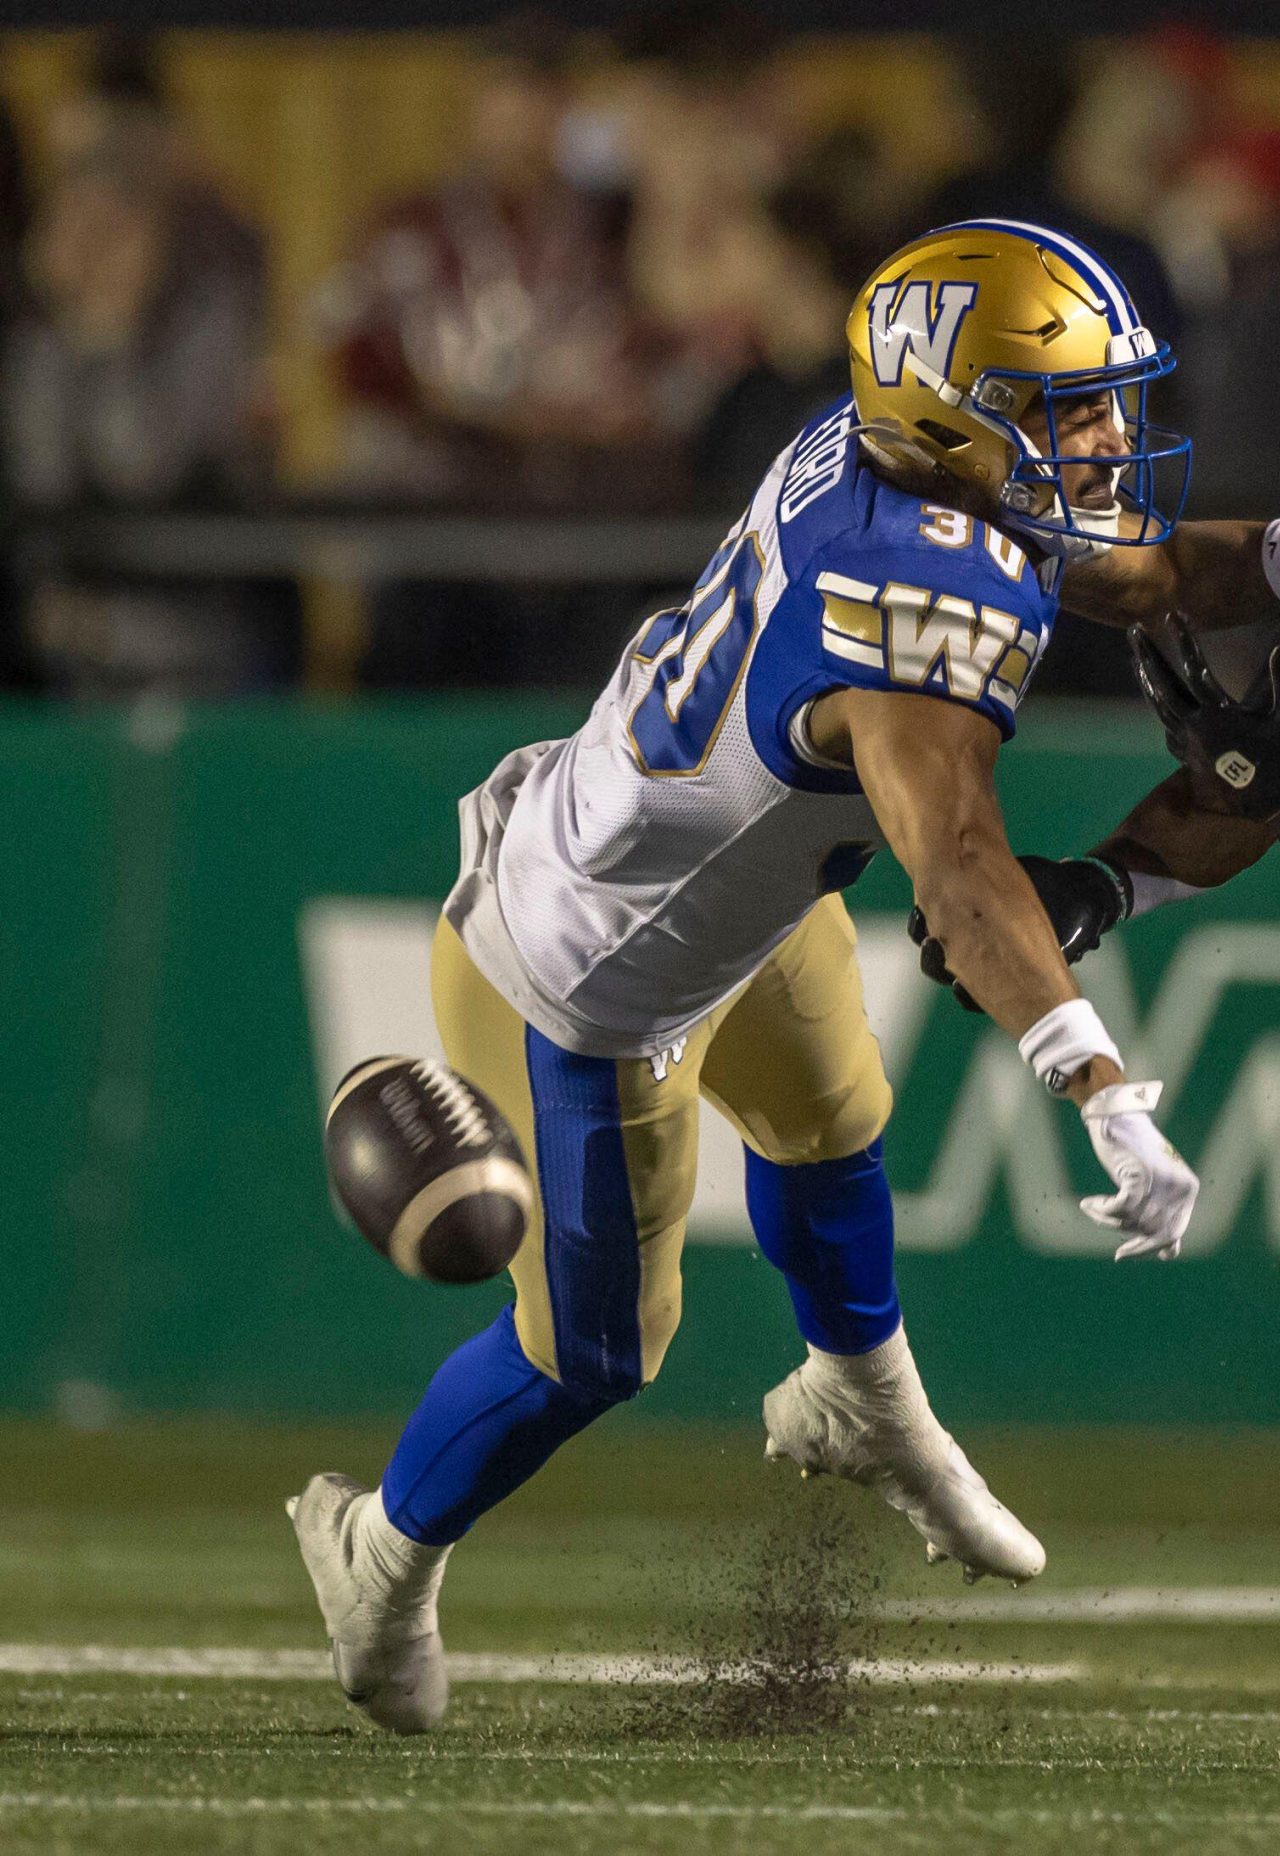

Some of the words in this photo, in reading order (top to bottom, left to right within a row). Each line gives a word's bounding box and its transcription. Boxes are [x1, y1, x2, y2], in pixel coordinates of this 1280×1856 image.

[866, 281, 980, 388] W
[879, 580, 1021, 702] W
[1223, 760, 1250, 782] CFL
